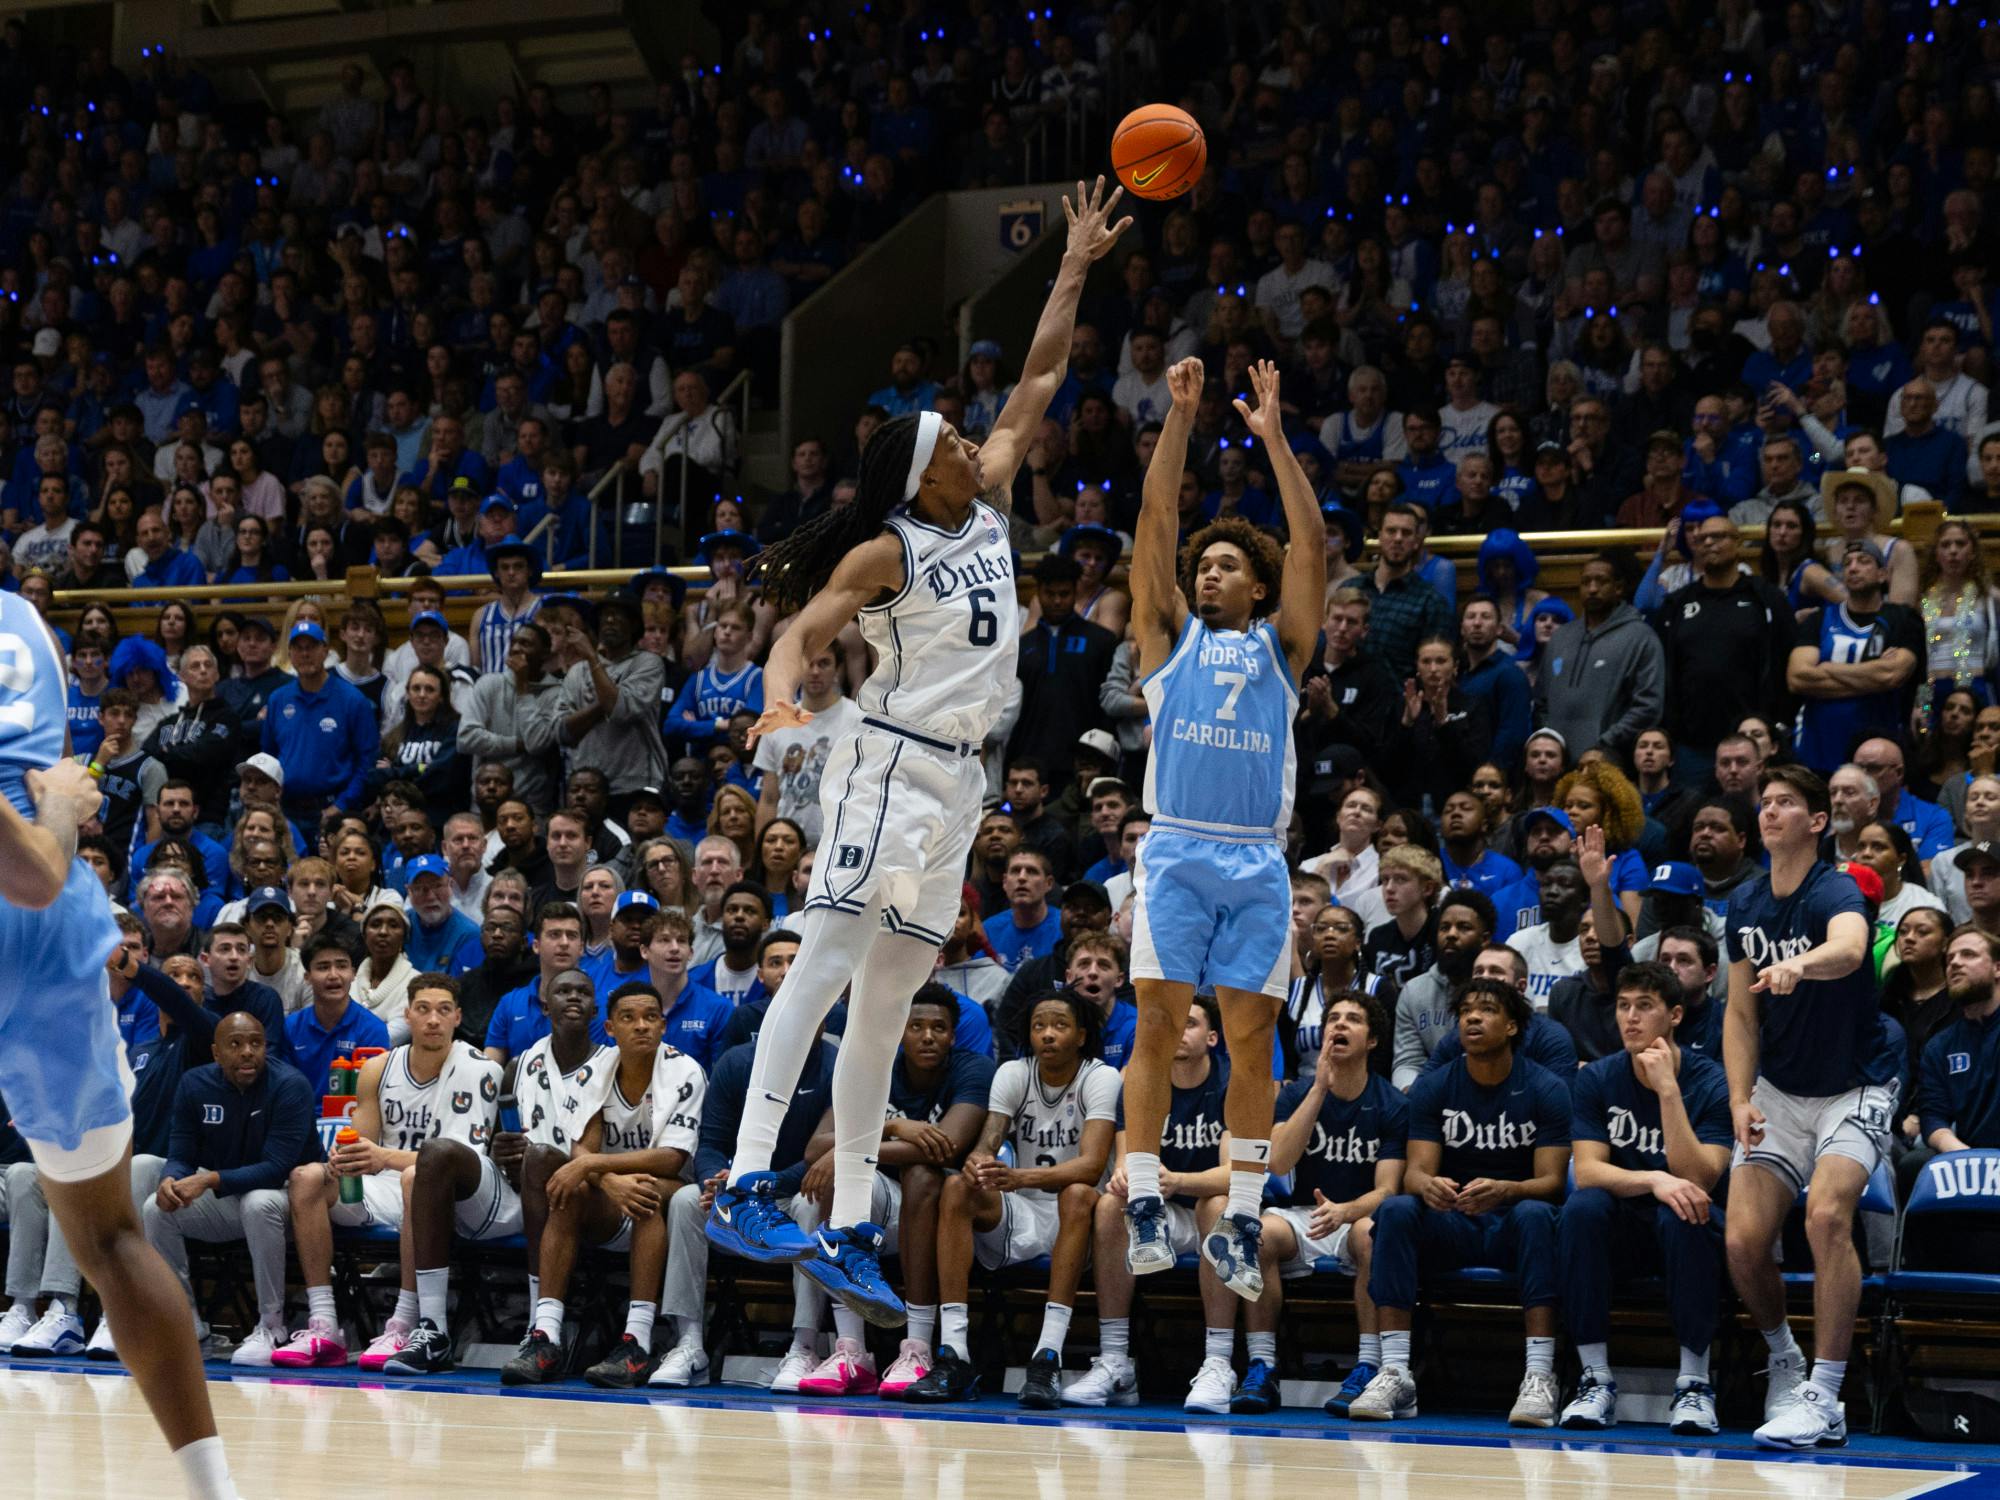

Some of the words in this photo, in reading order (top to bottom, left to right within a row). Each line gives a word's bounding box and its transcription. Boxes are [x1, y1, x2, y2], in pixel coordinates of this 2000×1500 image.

[1010, 216, 1030, 247] 6
[927, 551, 1010, 604] Duke
[968, 590, 998, 648] 6
[1198, 645, 1260, 678] NORTH
[1214, 671, 1247, 722] 7
[67, 706, 100, 721] DUK
[397, 740, 442, 765] UK
[1172, 718, 1272, 755] CAROLINA
[1652, 864, 1672, 882] D
[384, 1098, 432, 1130] Duk
[1442, 1108, 1537, 1150] Duke
[1605, 1105, 1663, 1155] Du
[605, 1122, 651, 1151] Duk
[1254, 1145, 1268, 1160] 7
[1928, 1158, 2000, 1199] DUK
